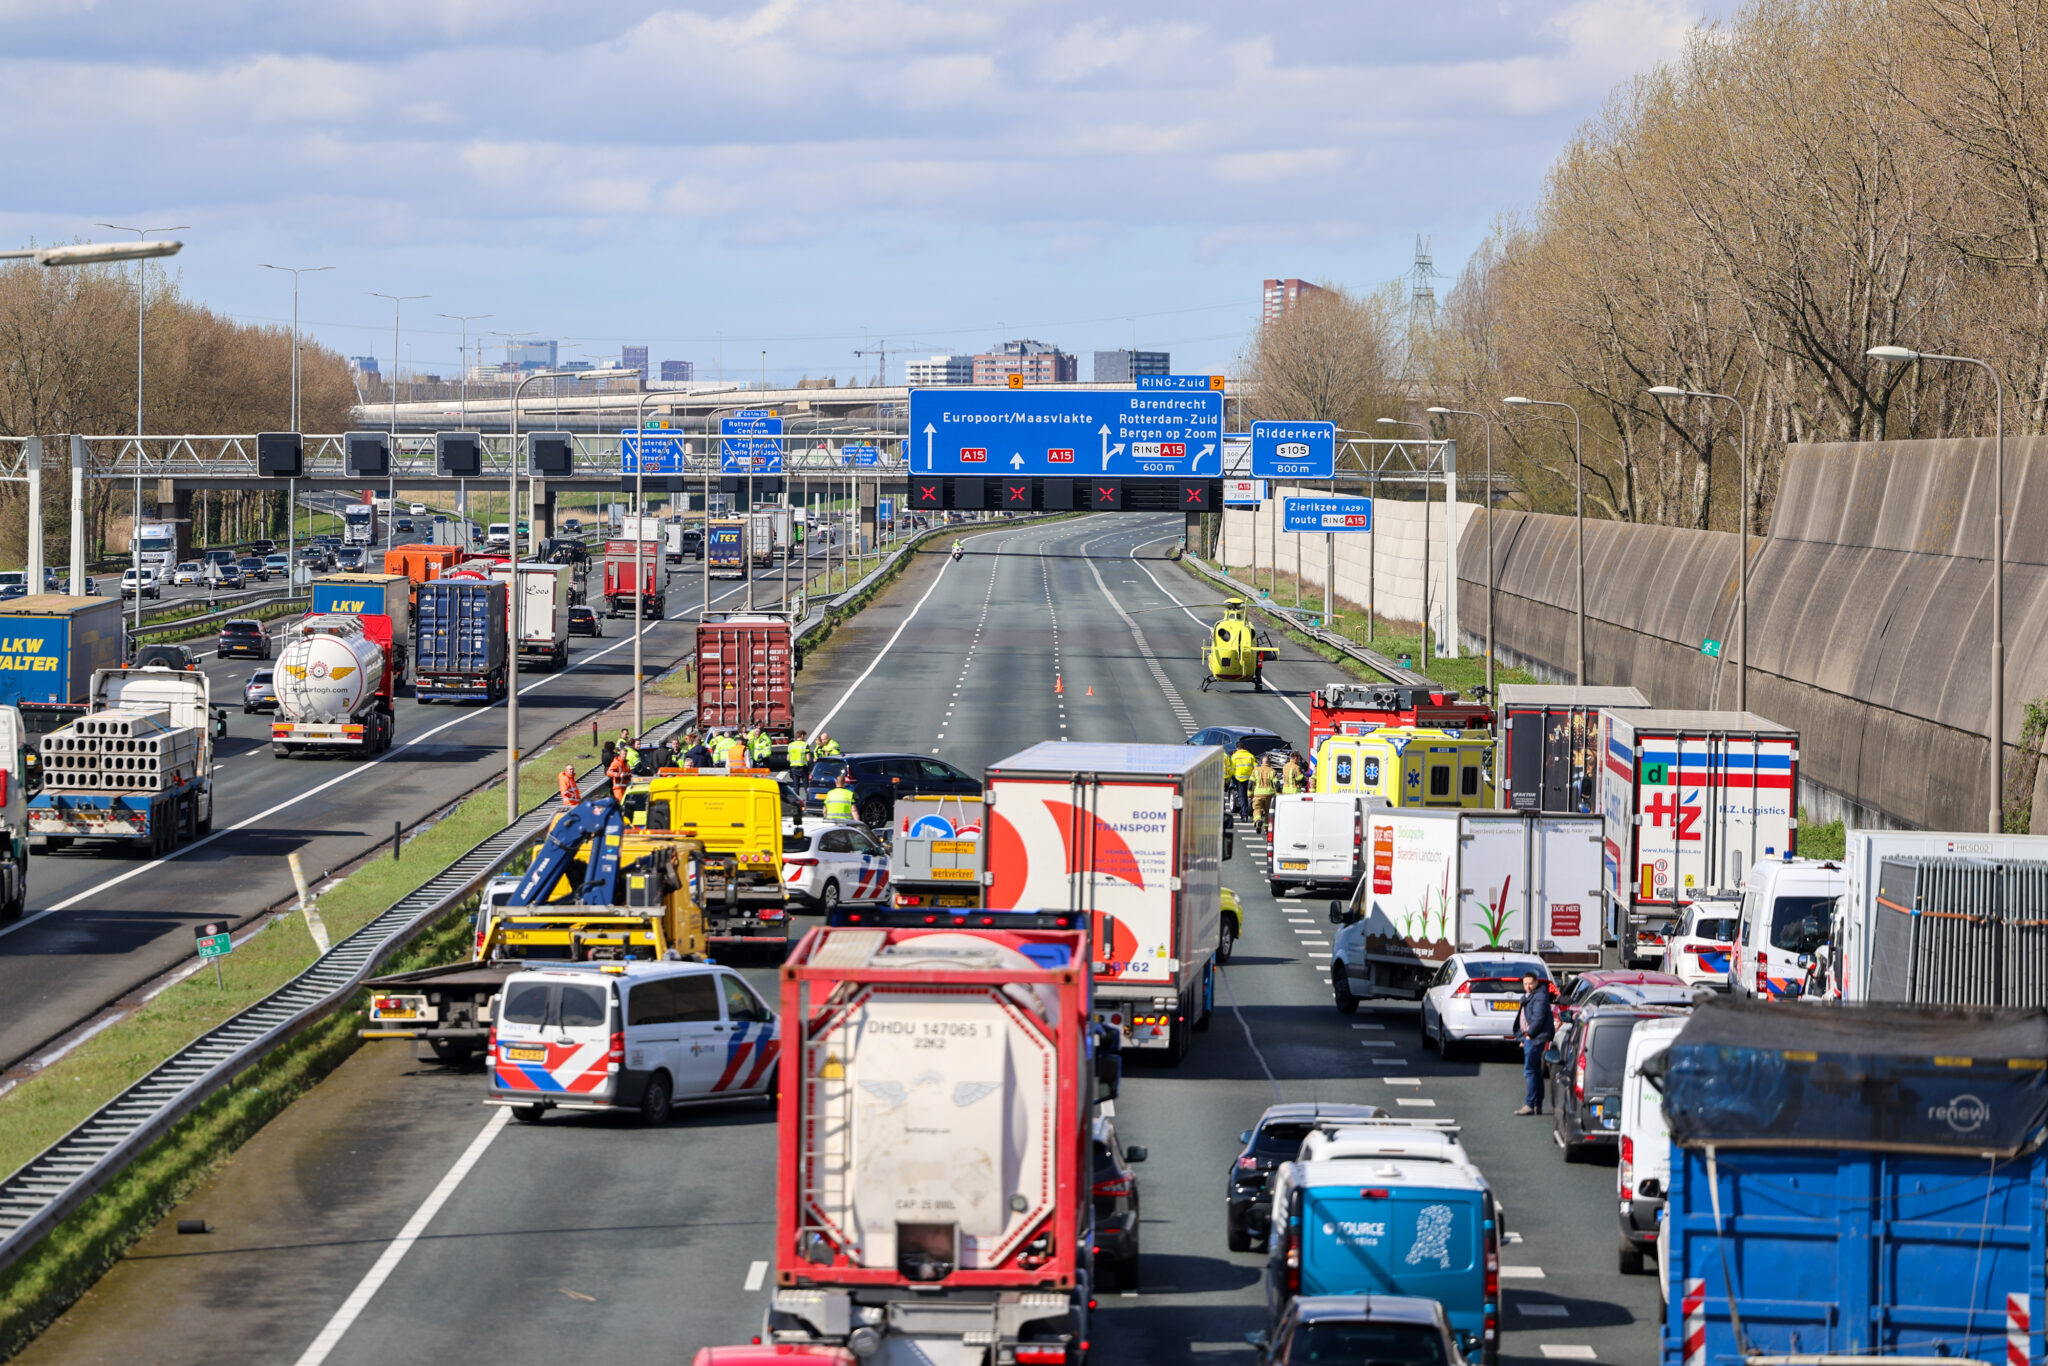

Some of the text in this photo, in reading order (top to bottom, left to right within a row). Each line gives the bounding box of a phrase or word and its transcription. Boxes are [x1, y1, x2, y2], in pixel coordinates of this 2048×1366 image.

[1012, 377, 1020, 386] 9
[1141, 378, 1205, 387] RING-Zuid
[1213, 378, 1221, 387] 9
[1130, 398, 1207, 409] Barendrecht
[942, 412, 1094, 425] Europoort/Maasvlakte
[1119, 413, 1218, 425] Rotterdam-Zuid
[1119, 428, 1217, 441] Bergen op Zoom
[1256, 428, 1331, 439] Ridderkerk
[962, 450, 985, 460] A15
[1050, 450, 1072, 460] A15
[1133, 445, 1184, 455] RING A15
[1280, 445, 1307, 455] s105
[1142, 463, 1163, 472] 600
[1277, 464, 1298, 473] 800
[1289, 502, 1337, 512] Zierikzee
[1290, 516, 1317, 525] route
[1346, 517, 1365, 525] A15
[426, 561, 442, 571] 391
[331, 600, 365, 613] LKW
[1, 637, 45, 654] LKW
[1647, 764, 1662, 783] d
[1132, 810, 1167, 820] BOOM
[1719, 805, 1786, 816] H.Z. Logistics
[1096, 823, 1167, 833] TRANSPORT
[932, 868, 974, 879] werkverkeer
[1113, 961, 1150, 973] BT62
[868, 1020, 992, 1038] DHDU 147065 1
[1927, 1103, 1991, 1122] renewi
